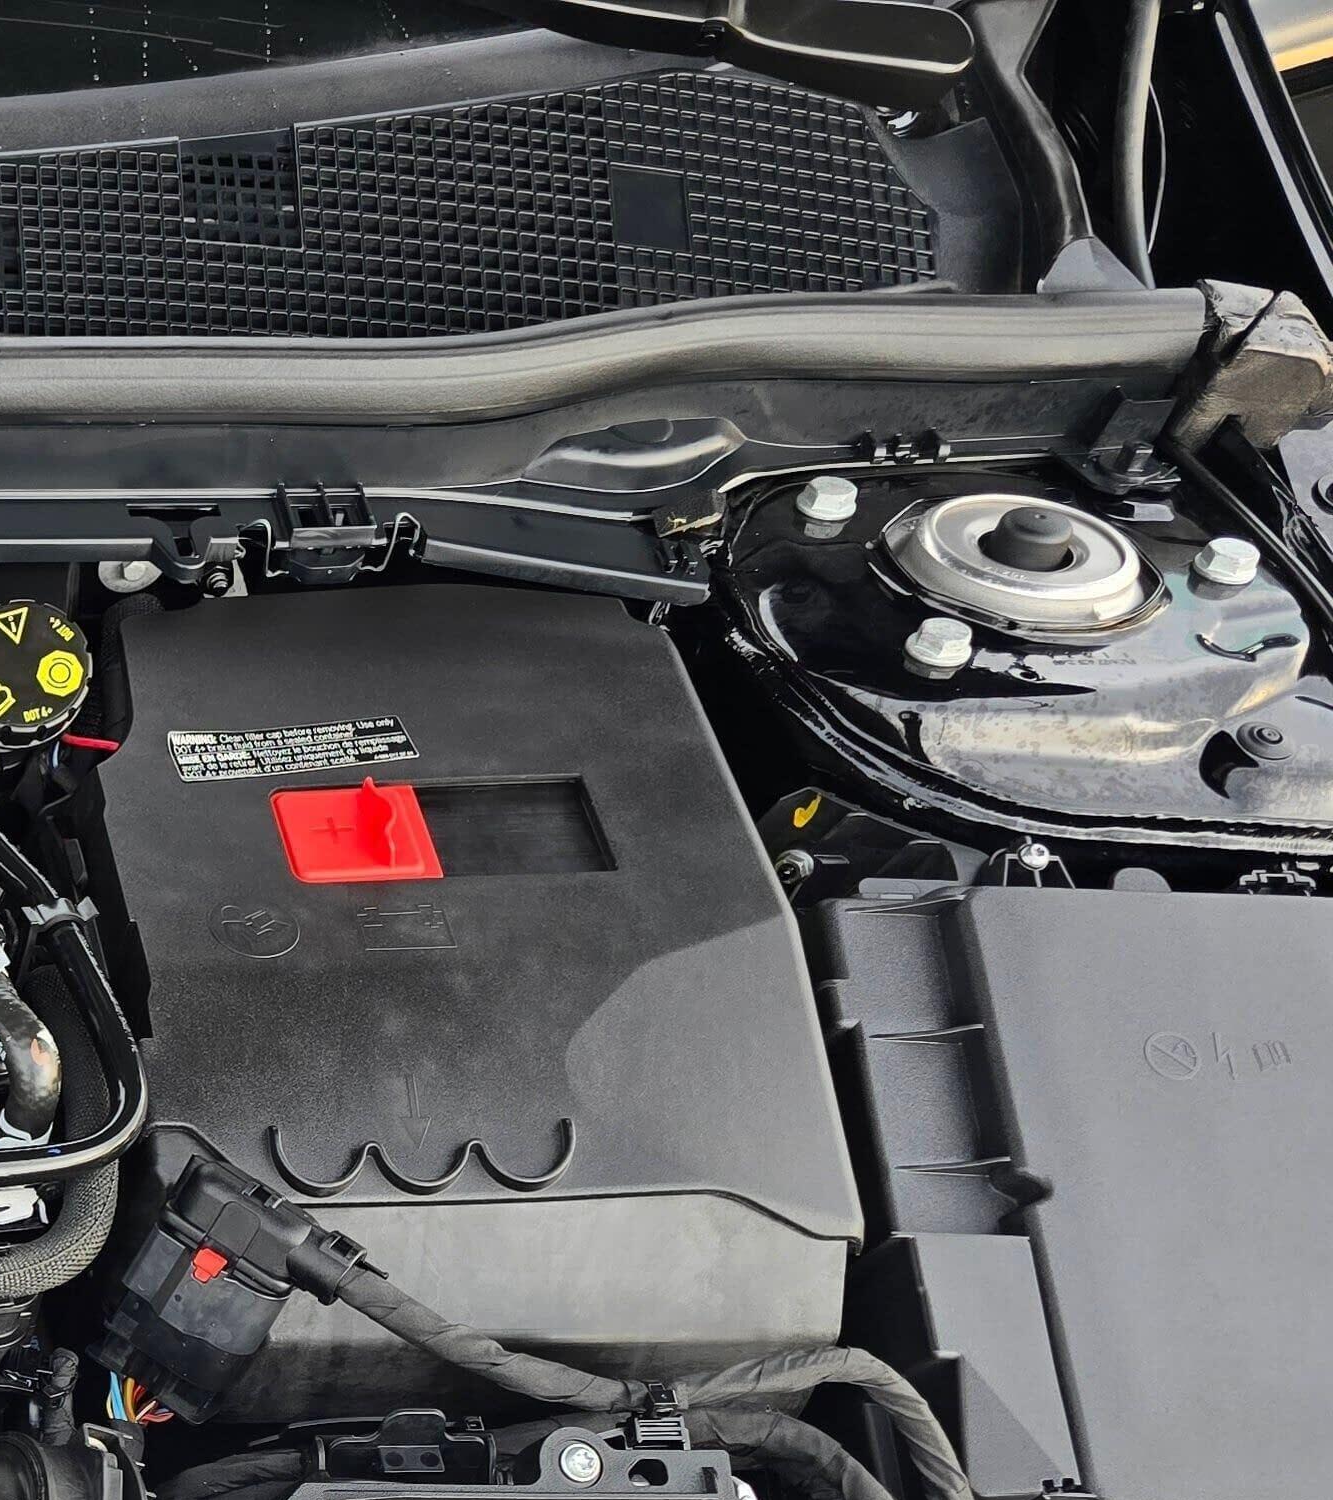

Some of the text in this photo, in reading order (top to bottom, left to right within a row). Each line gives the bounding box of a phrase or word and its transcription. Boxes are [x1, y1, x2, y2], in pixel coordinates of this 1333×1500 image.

[56, 624, 76, 642] DOT
[23, 708, 40, 723] DOT
[172, 734, 217, 745] WARNING:
[219, 734, 244, 743] Clean
[245, 732, 264, 741] filler
[266, 731, 282, 742] cap
[282, 728, 312, 737] before
[355, 720, 375, 729] Use
[375, 718, 394, 728] only
[173, 745, 193, 754] DOT
[254, 738, 276, 747] from
[302, 742, 341, 752] bouchon
